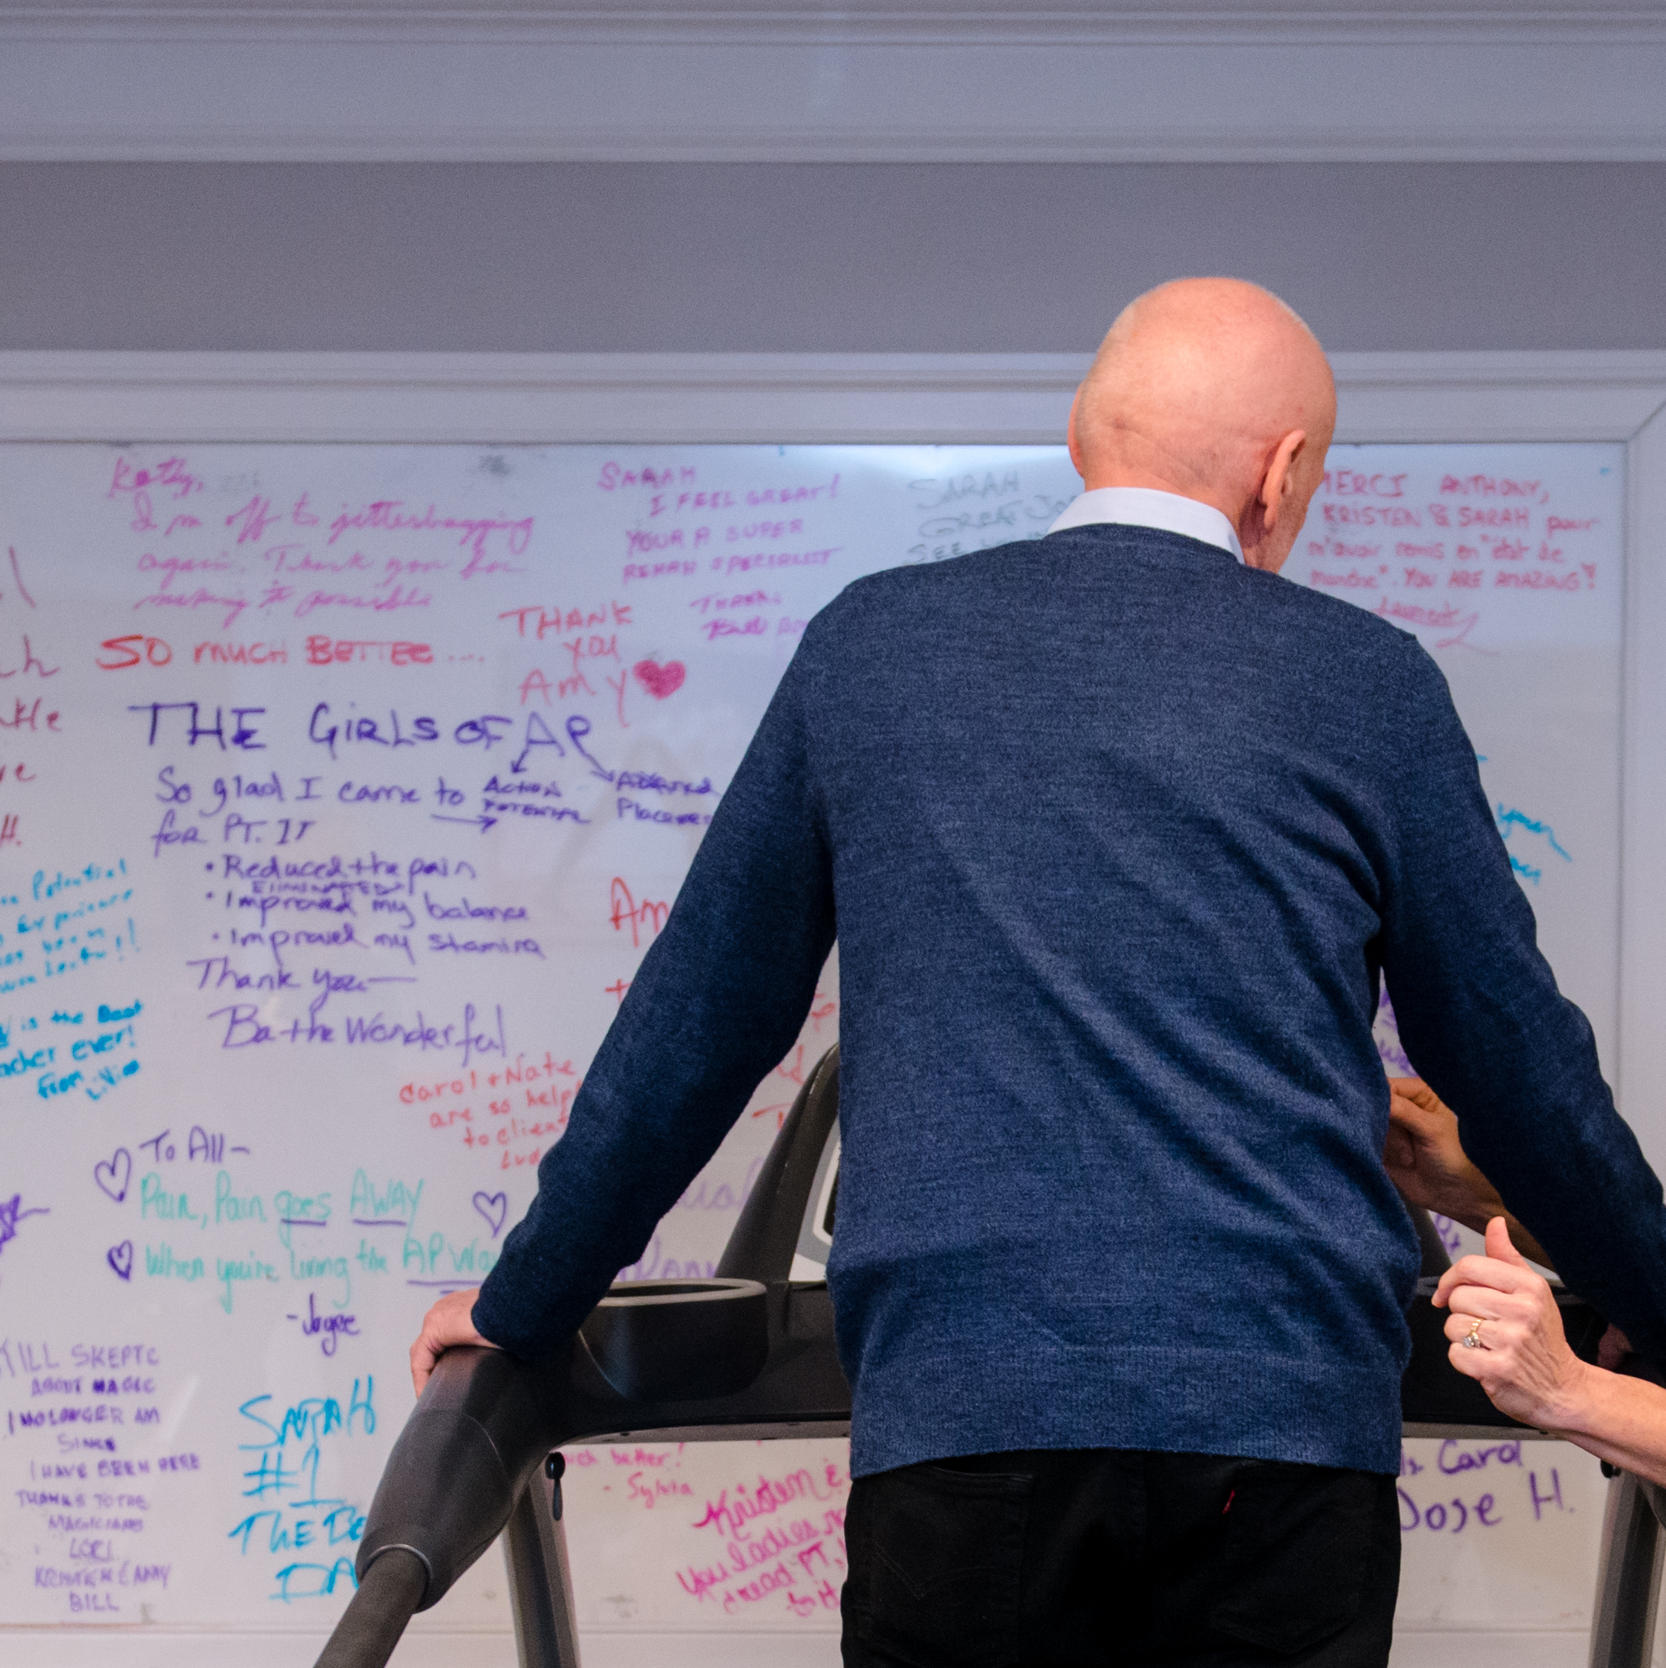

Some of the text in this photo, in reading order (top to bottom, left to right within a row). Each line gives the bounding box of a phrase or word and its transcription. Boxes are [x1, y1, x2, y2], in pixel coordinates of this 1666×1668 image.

[129, 701, 267, 751] THE
[155, 765, 467, 818] So glad I came to
[407, 856, 476, 896] pain
[186, 955, 301, 993] Thank
